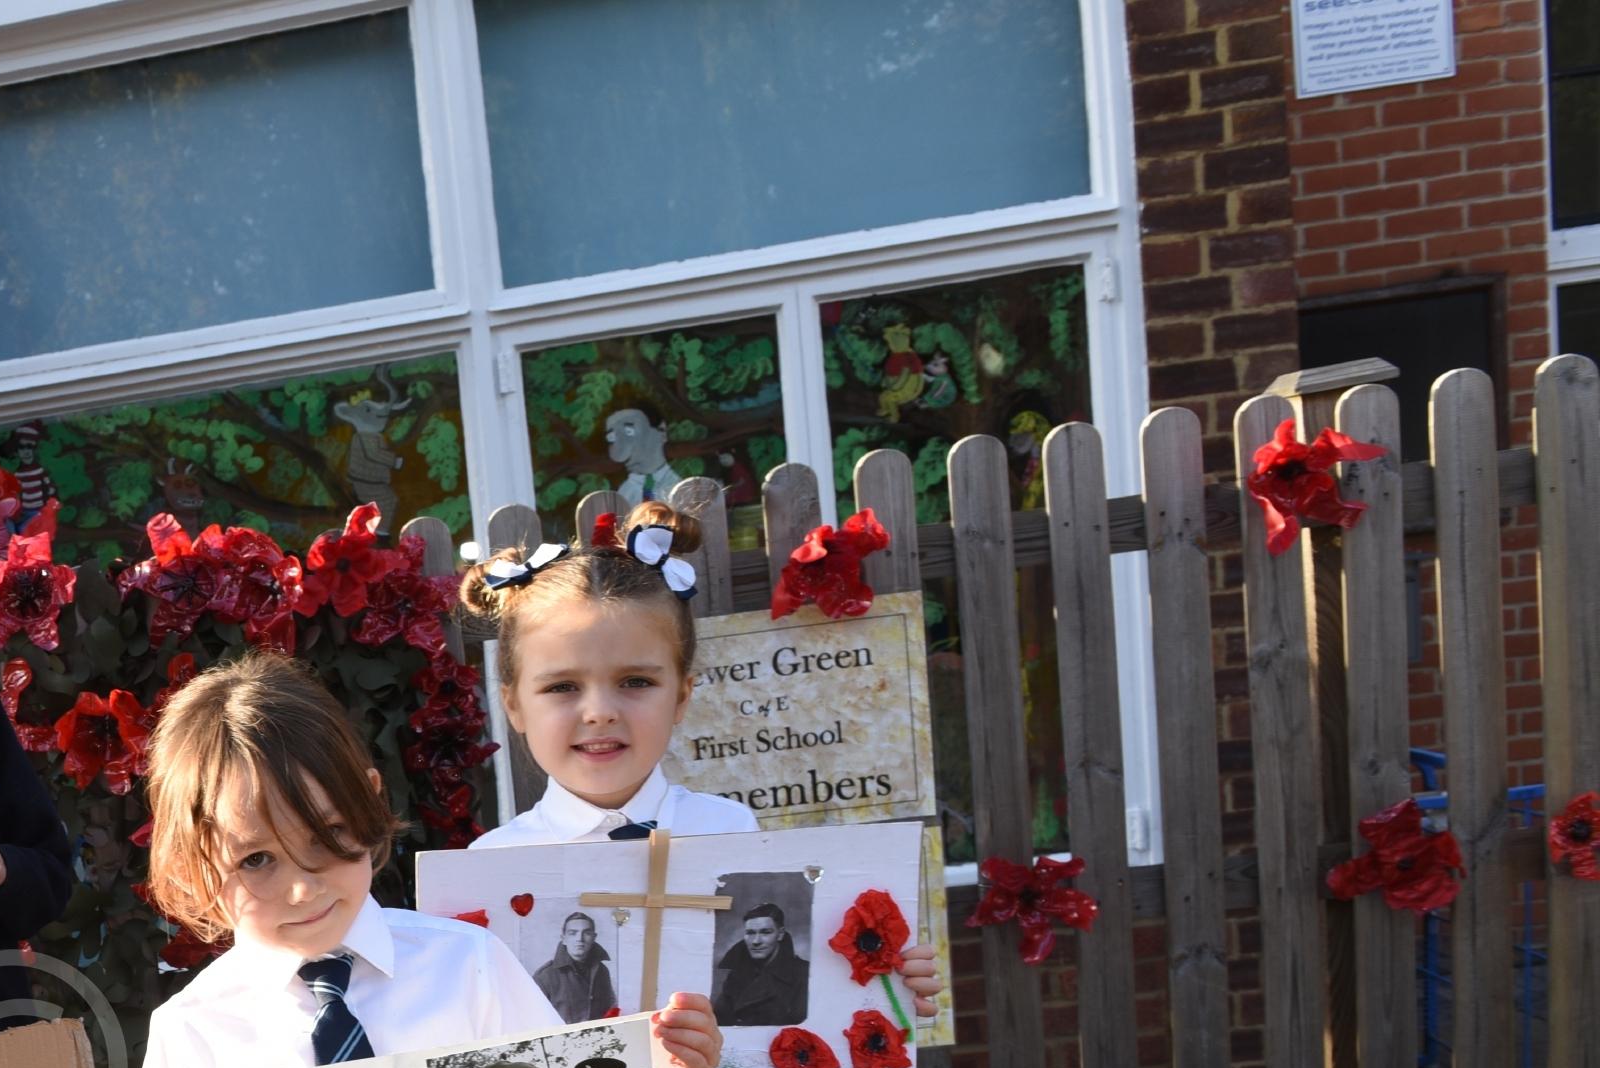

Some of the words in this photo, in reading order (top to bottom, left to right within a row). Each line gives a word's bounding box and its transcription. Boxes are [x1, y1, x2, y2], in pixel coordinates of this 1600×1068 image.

[772, 646, 873, 677] Green
[740, 699, 753, 716] C
[758, 699, 771, 718] of
[776, 695, 790, 711] E
[692, 736, 749, 761] First
[756, 721, 844, 754] School
